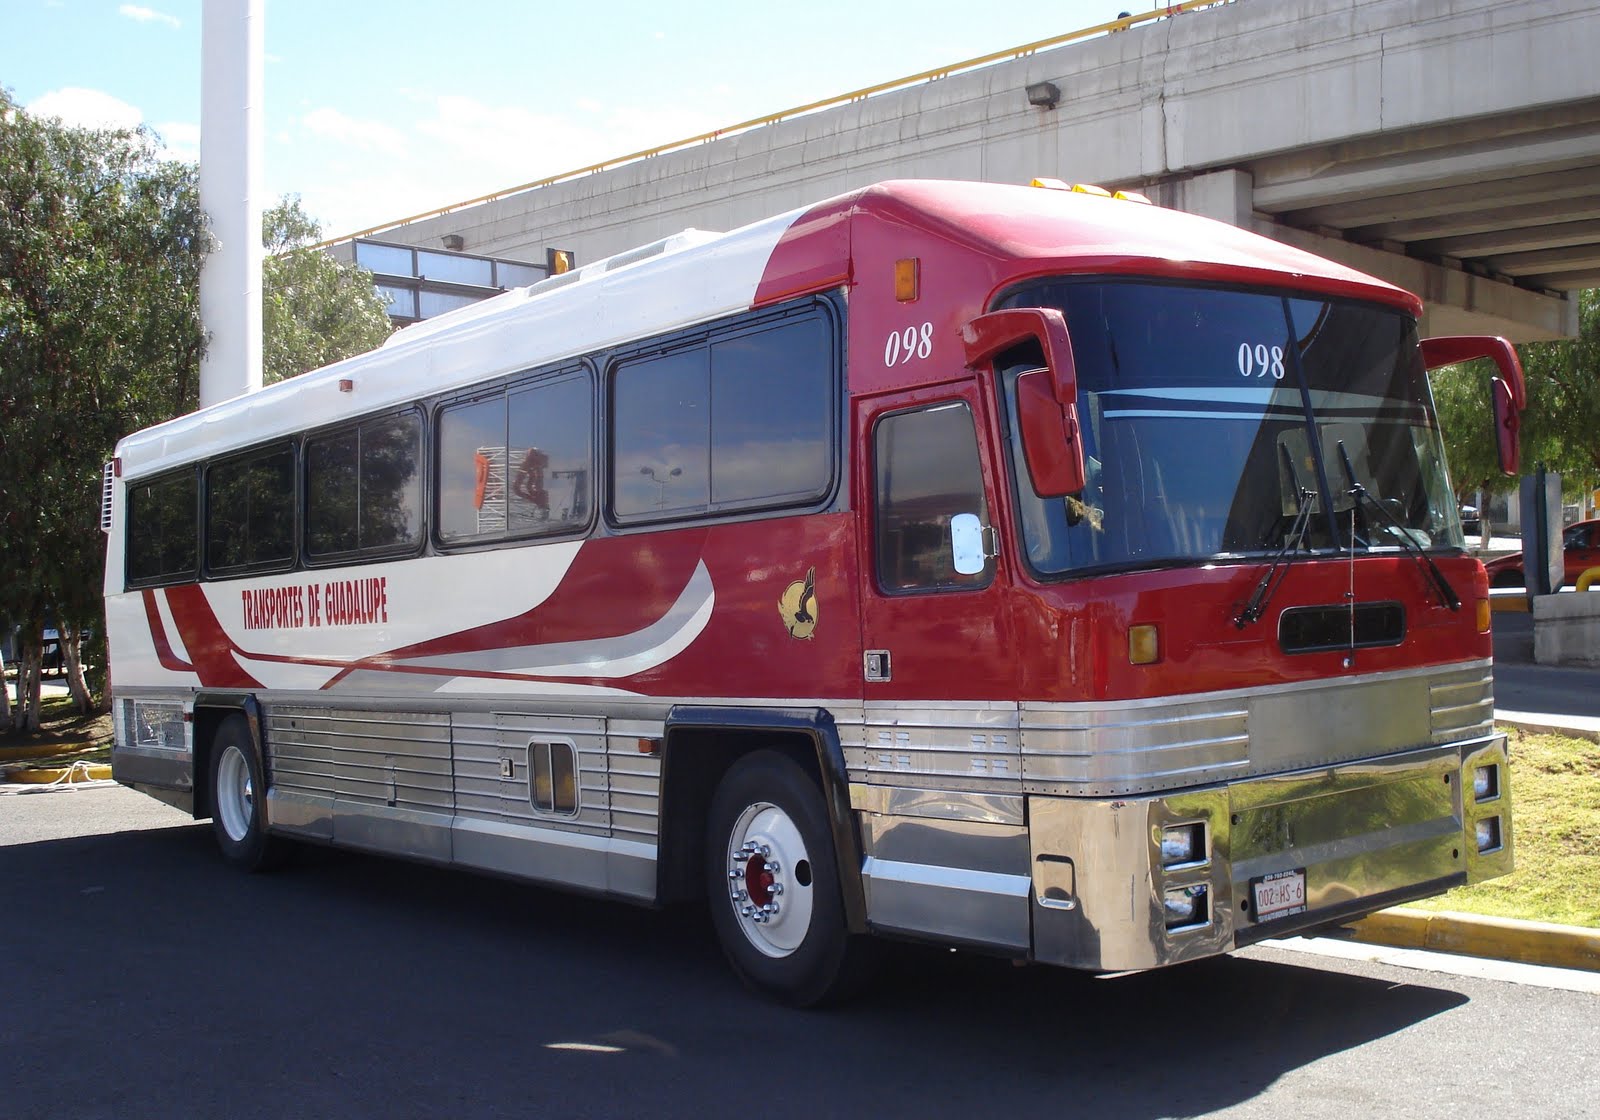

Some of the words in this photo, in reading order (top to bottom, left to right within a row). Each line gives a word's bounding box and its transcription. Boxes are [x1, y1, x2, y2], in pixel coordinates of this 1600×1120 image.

[885, 321, 934, 368] 098
[1238, 342, 1285, 379] 098
[242, 586, 304, 630] TRANSPORTES
[308, 584, 321, 627] DE
[325, 577, 388, 626] GUADALUPE
[1258, 882, 1302, 907] 002-HS-6
